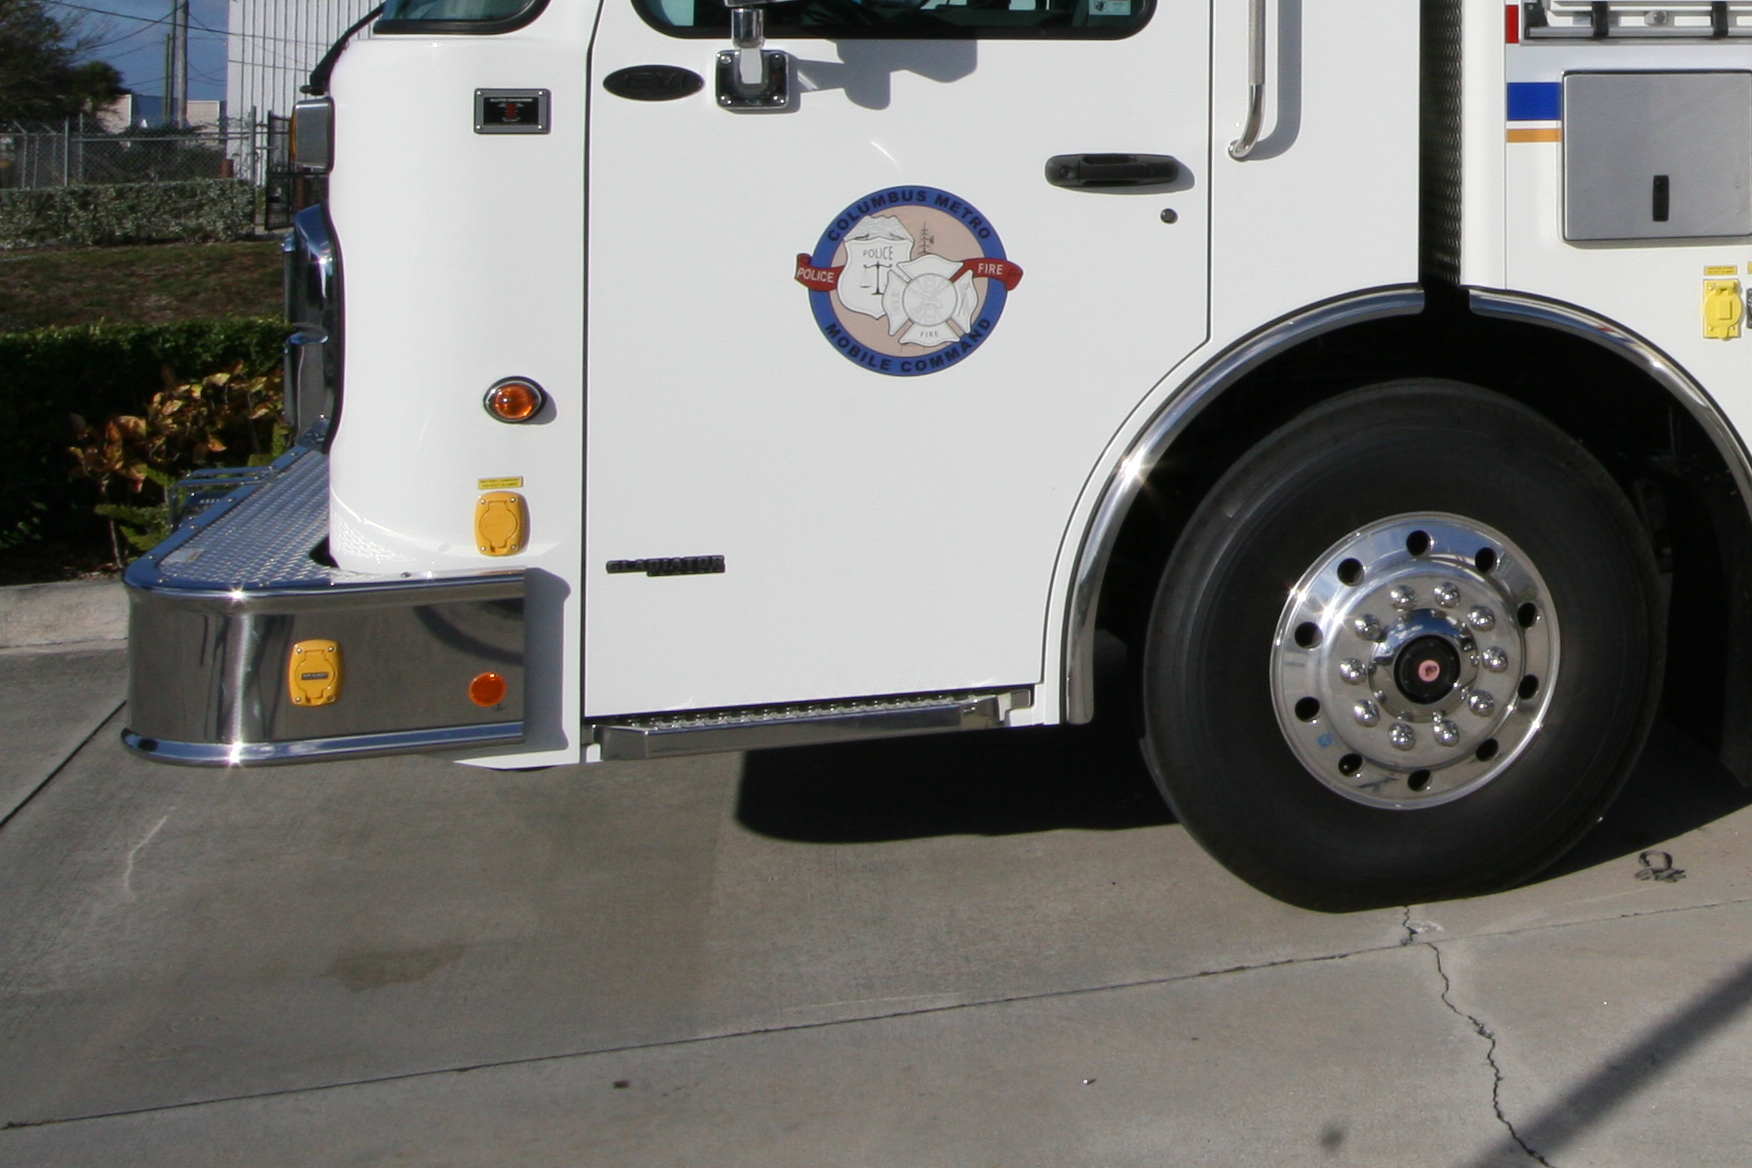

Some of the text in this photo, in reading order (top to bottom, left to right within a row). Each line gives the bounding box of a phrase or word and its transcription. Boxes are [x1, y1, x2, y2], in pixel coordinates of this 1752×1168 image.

[827, 190, 991, 242] COLUMBUS METRO
[863, 246, 894, 261] POLICE
[796, 267, 835, 283] POLICE
[977, 263, 1004, 275] FIRE
[920, 330, 939, 338] FIRE
[825, 319, 991, 373] MOBILE COMMAND
